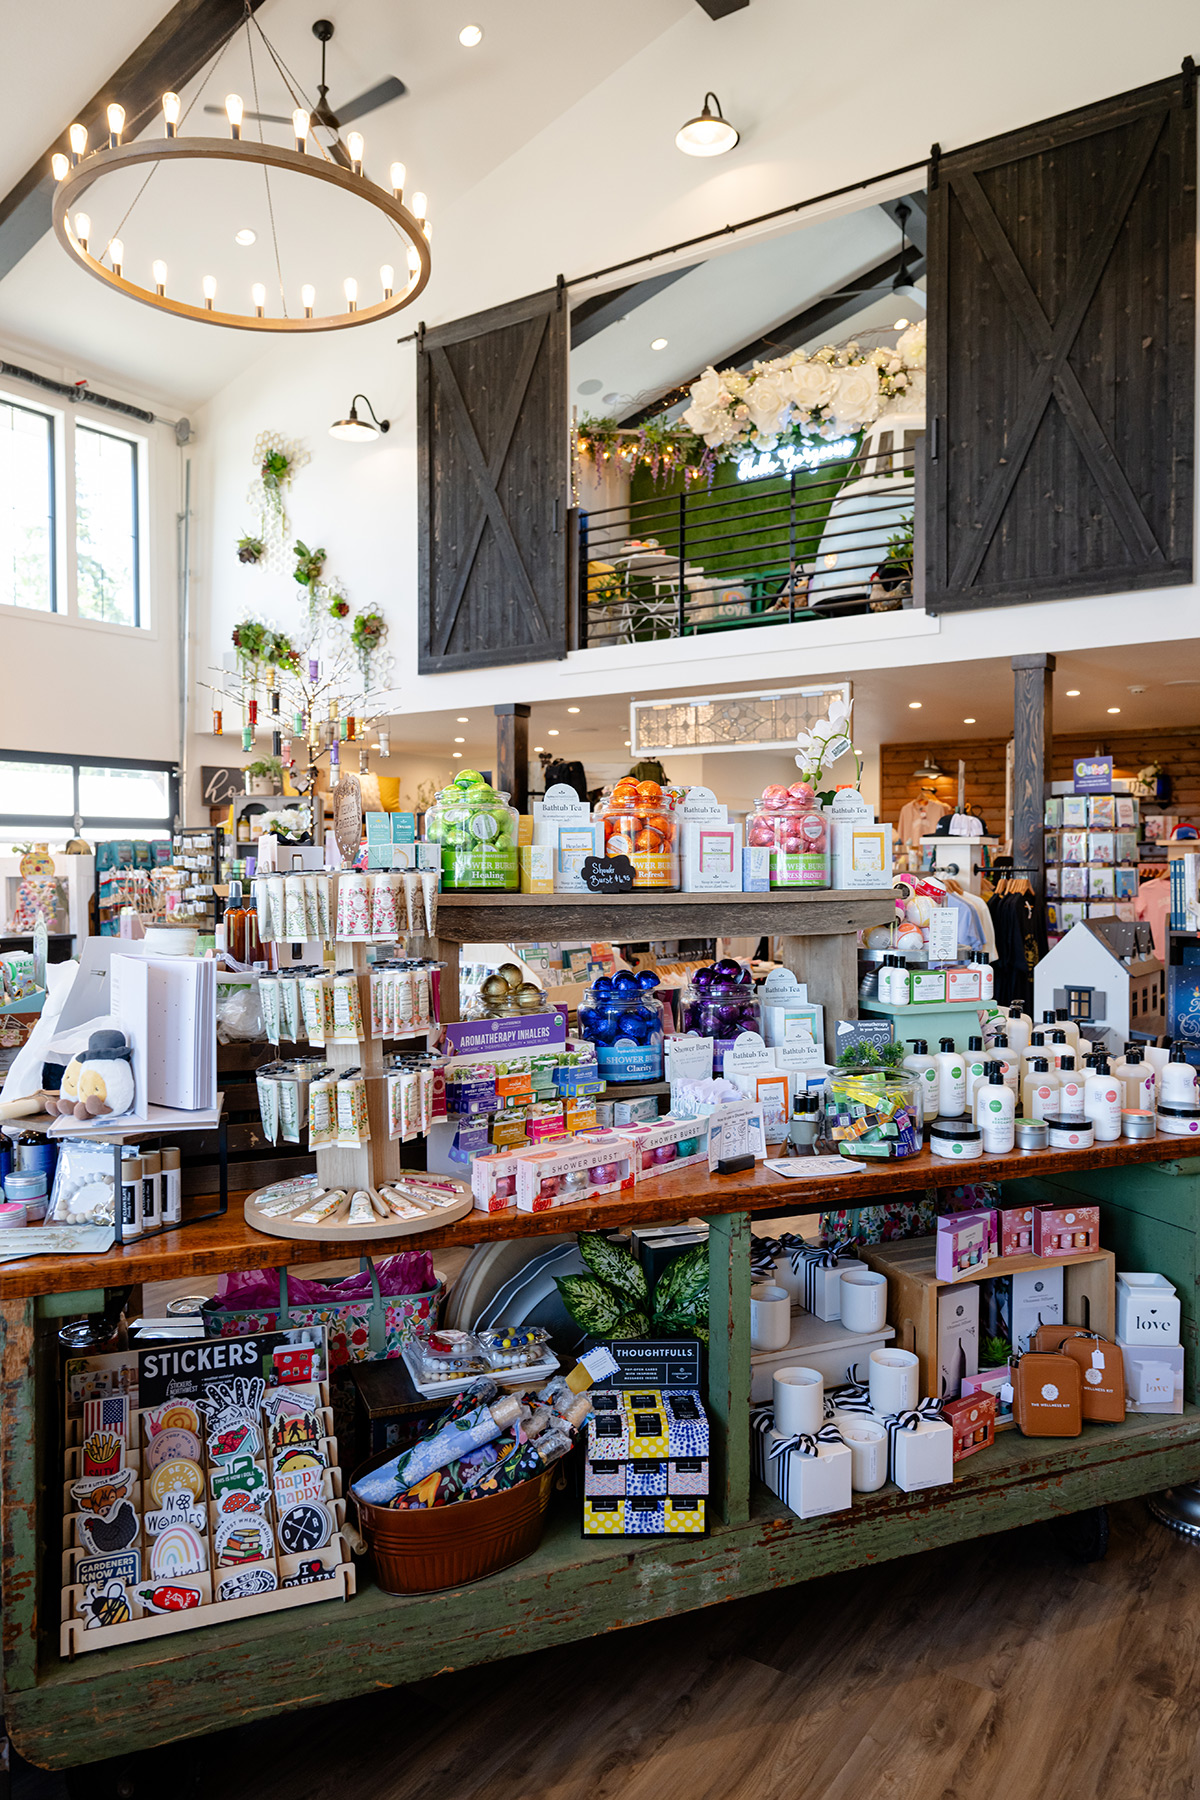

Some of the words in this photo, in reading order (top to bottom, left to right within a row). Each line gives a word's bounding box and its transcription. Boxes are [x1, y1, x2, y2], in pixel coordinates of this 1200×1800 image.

[718, 605, 750, 616] LOVE
[495, 862, 515, 870] BURST
[592, 862, 615, 876] Shower
[472, 872, 504, 881] Healing
[590, 874, 613, 886] Burst
[460, 1030, 516, 1047] AROMATHERAPY
[517, 1027, 550, 1040] INHALERS
[674, 1044, 695, 1053] Shower
[782, 1047, 806, 1055] Bathtub
[606, 1055, 644, 1064] SHOWER
[626, 1064, 652, 1073] Clarity
[650, 1135, 679, 1147] SHOWER
[680, 1127, 700, 1138] BURST
[552, 1159, 588, 1174] SHOWER
[592, 1152, 618, 1164] BURST
[1136, 1316, 1171, 1332] love
[616, 1349, 693, 1357] THOUGHTFULLS
[144, 1341, 258, 1378] STICKERS
[170, 1380, 193, 1389] STICKERS
[170, 1385, 198, 1395] NORTHWEST
[1146, 1384, 1169, 1393] love
[163, 1400, 188, 1412] snailed
[168, 1465, 180, 1474] BE
[184, 1466, 197, 1483] THE
[275, 1469, 320, 1490] happy
[278, 1484, 321, 1506] happy
[217, 1521, 237, 1550] HAPPIEST
[258, 1520, 271, 1548] READING
[81, 1557, 134, 1573] GARDENERS
[301, 1564, 309, 1576] I
[81, 1570, 112, 1581] KNOW
[116, 1566, 134, 1576] ALL
[164, 1590, 172, 1606] STAY
[182, 1592, 191, 1609] SPICY
